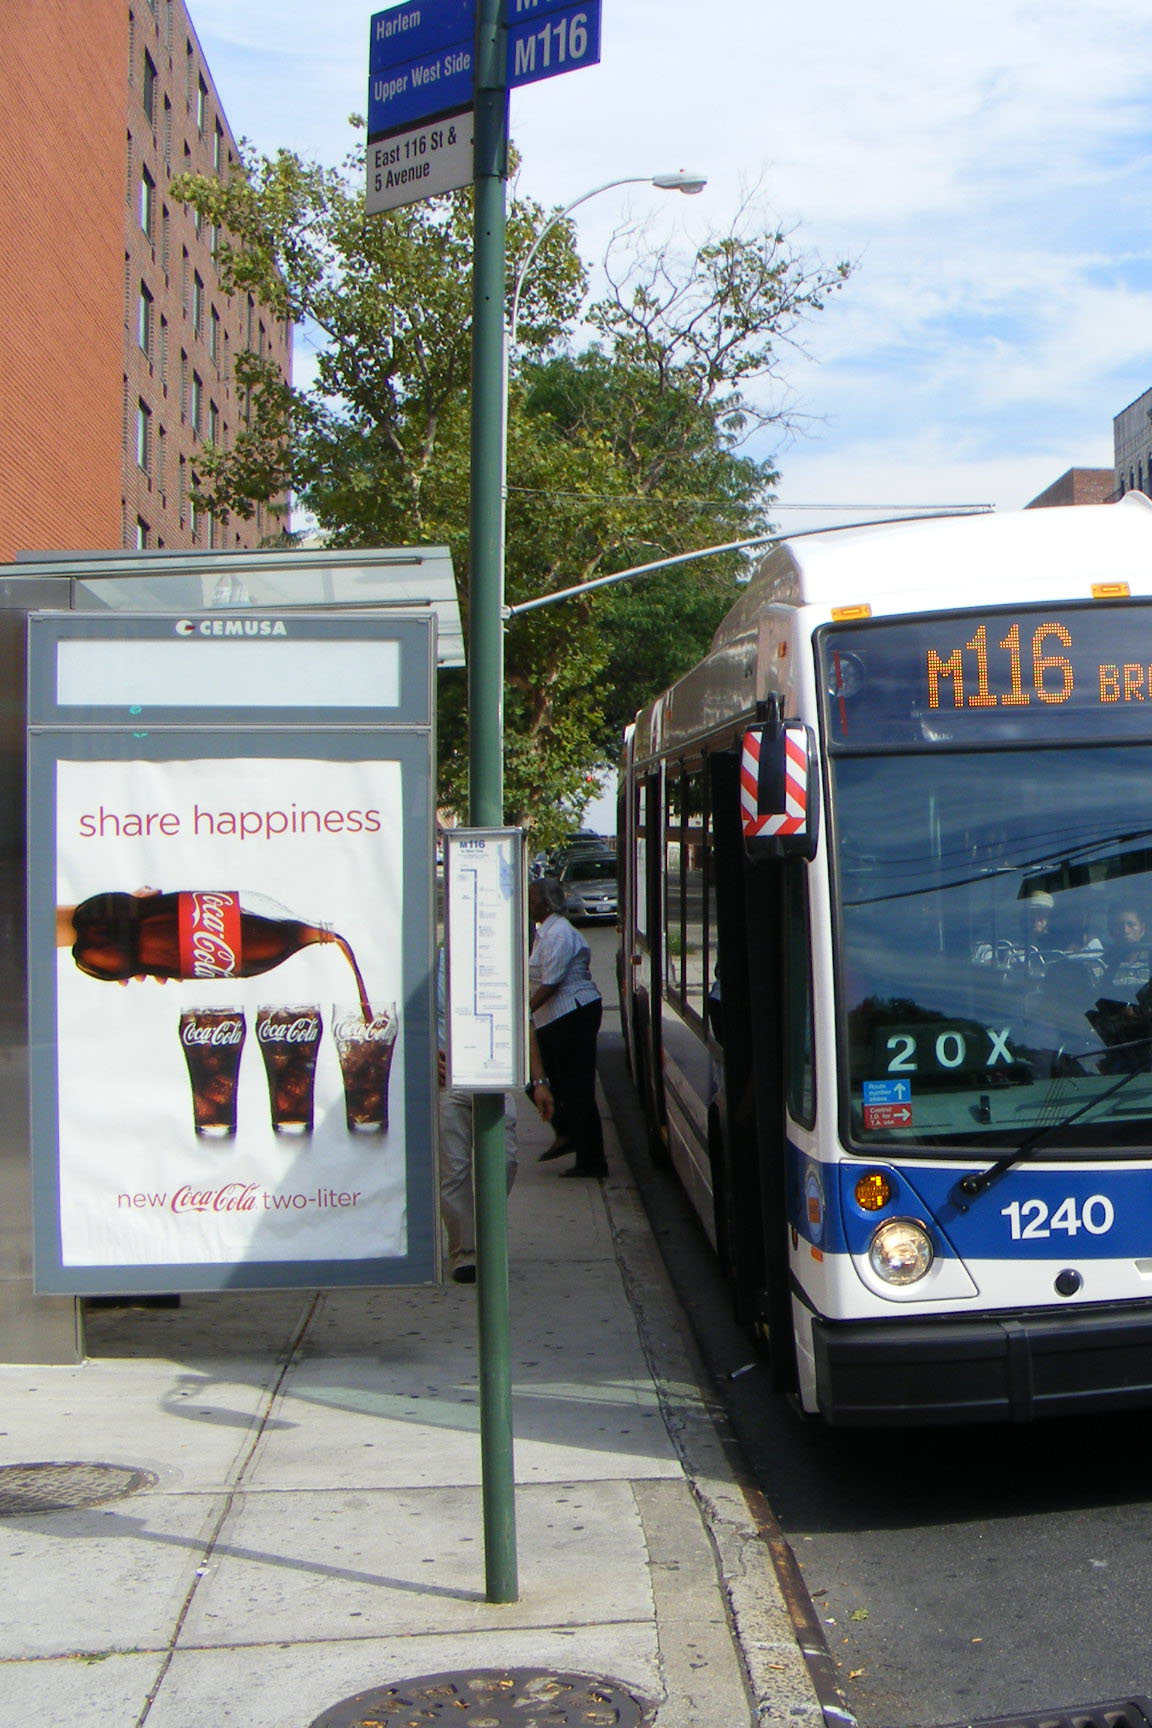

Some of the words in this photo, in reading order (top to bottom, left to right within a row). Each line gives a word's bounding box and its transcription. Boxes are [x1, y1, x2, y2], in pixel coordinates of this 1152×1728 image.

[376, 11, 421, 40] Harlem
[515, 13, 588, 76] M116
[374, 75, 408, 104] Upper
[411, 61, 441, 89] West
[444, 52, 471, 77] Side
[375, 146, 400, 169] East
[404, 136, 426, 160] 116
[431, 130, 443, 151] St
[447, 126, 457, 145] &
[375, 176, 382, 192] 5
[386, 161, 430, 189] Avenue
[200, 620, 287, 636] CEMUSA
[927, 622, 1074, 709] M116
[79, 806, 180, 838] share
[194, 803, 382, 840] happiness
[118, 1192, 166, 1209] new
[262, 1188, 361, 1210] two-liter
[1001, 1194, 1114, 1240] 1240
